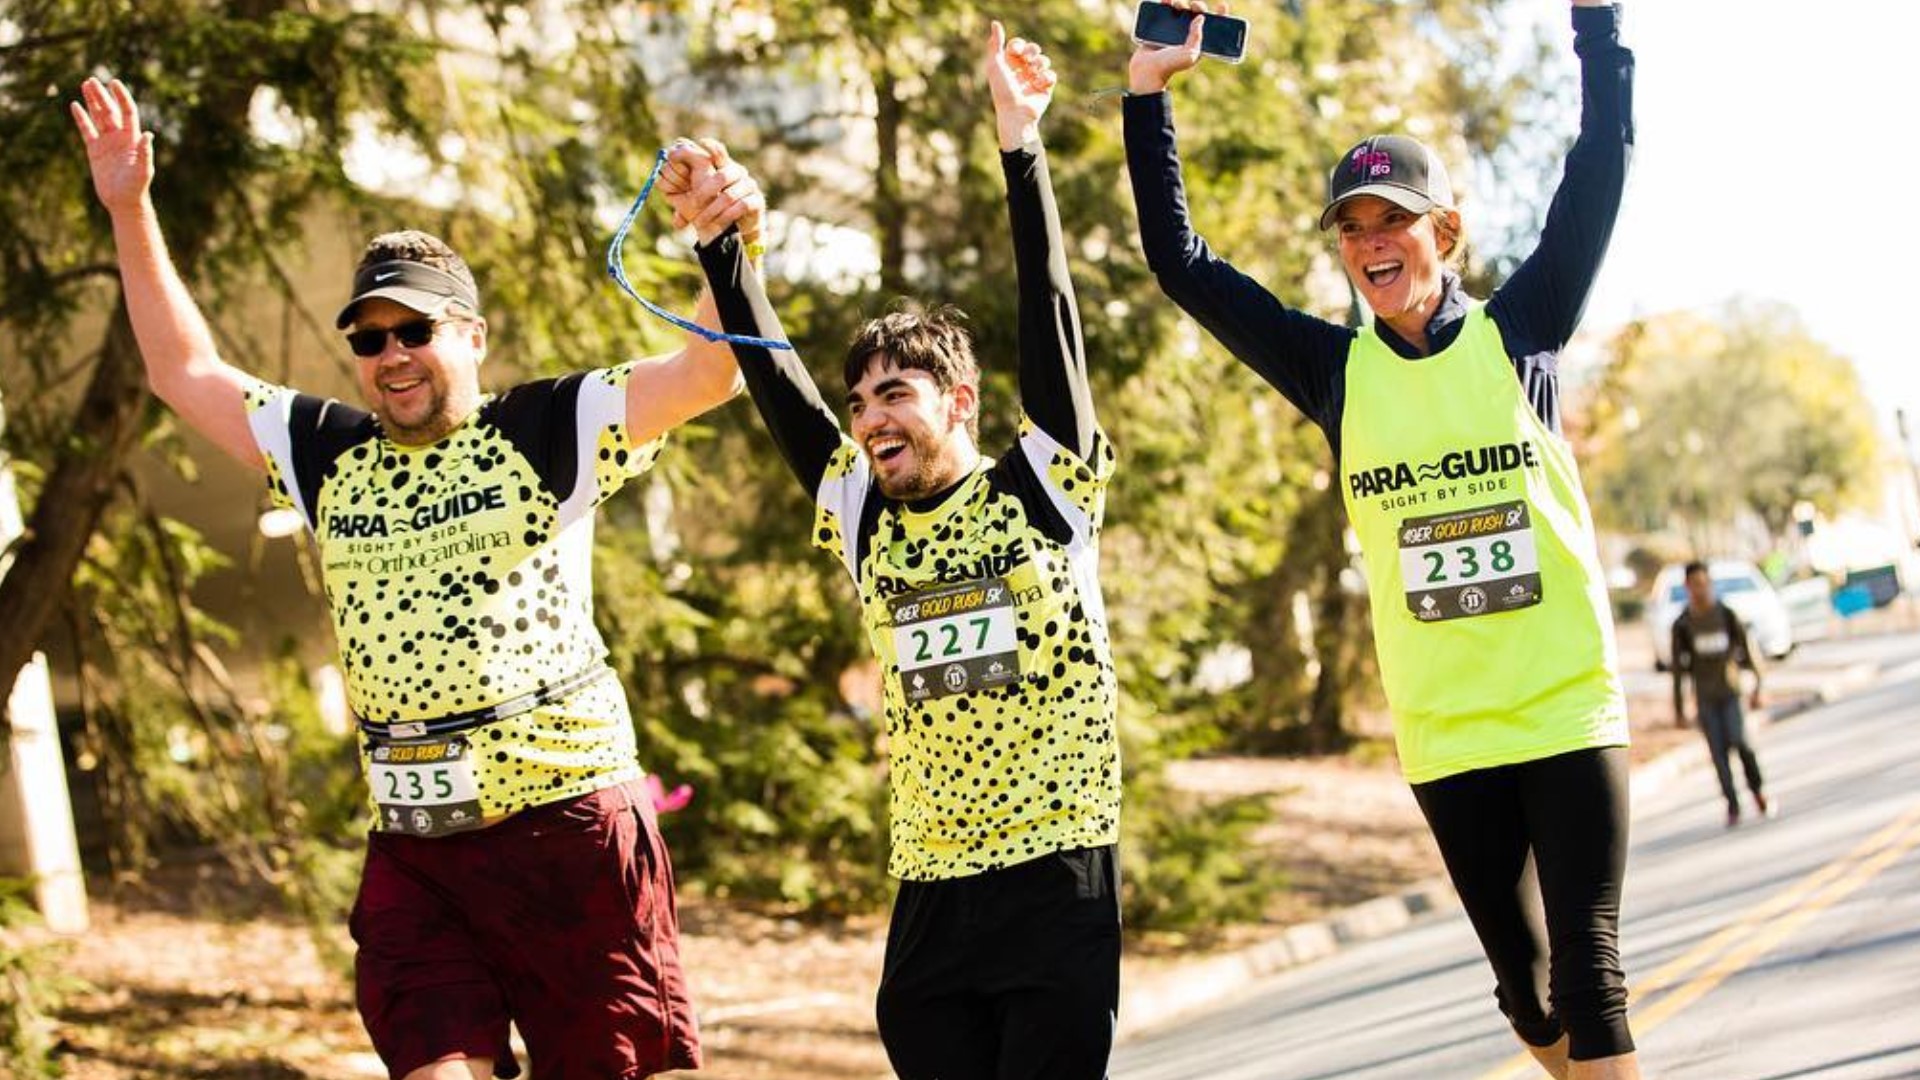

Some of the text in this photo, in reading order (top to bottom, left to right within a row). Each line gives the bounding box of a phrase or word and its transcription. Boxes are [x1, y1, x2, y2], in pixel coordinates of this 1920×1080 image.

[1349, 462, 1417, 499] PARA
[1381, 478, 1508, 511] SIGHT BY SIDE
[328, 485, 506, 539] PARA GUIDE
[1403, 525, 1432, 544] 49ER
[1434, 519, 1468, 540] GOLD
[1469, 513, 1505, 534] RUSH
[1505, 505, 1523, 527] 5K
[347, 521, 469, 553] SIGHT BY SIDE
[1423, 540, 1516, 583] 238
[921, 598, 951, 618] GOLD
[952, 590, 985, 611] RUSH
[985, 584, 1004, 605] 5K
[911, 617, 991, 662] 227
[384, 769, 453, 800] 235
